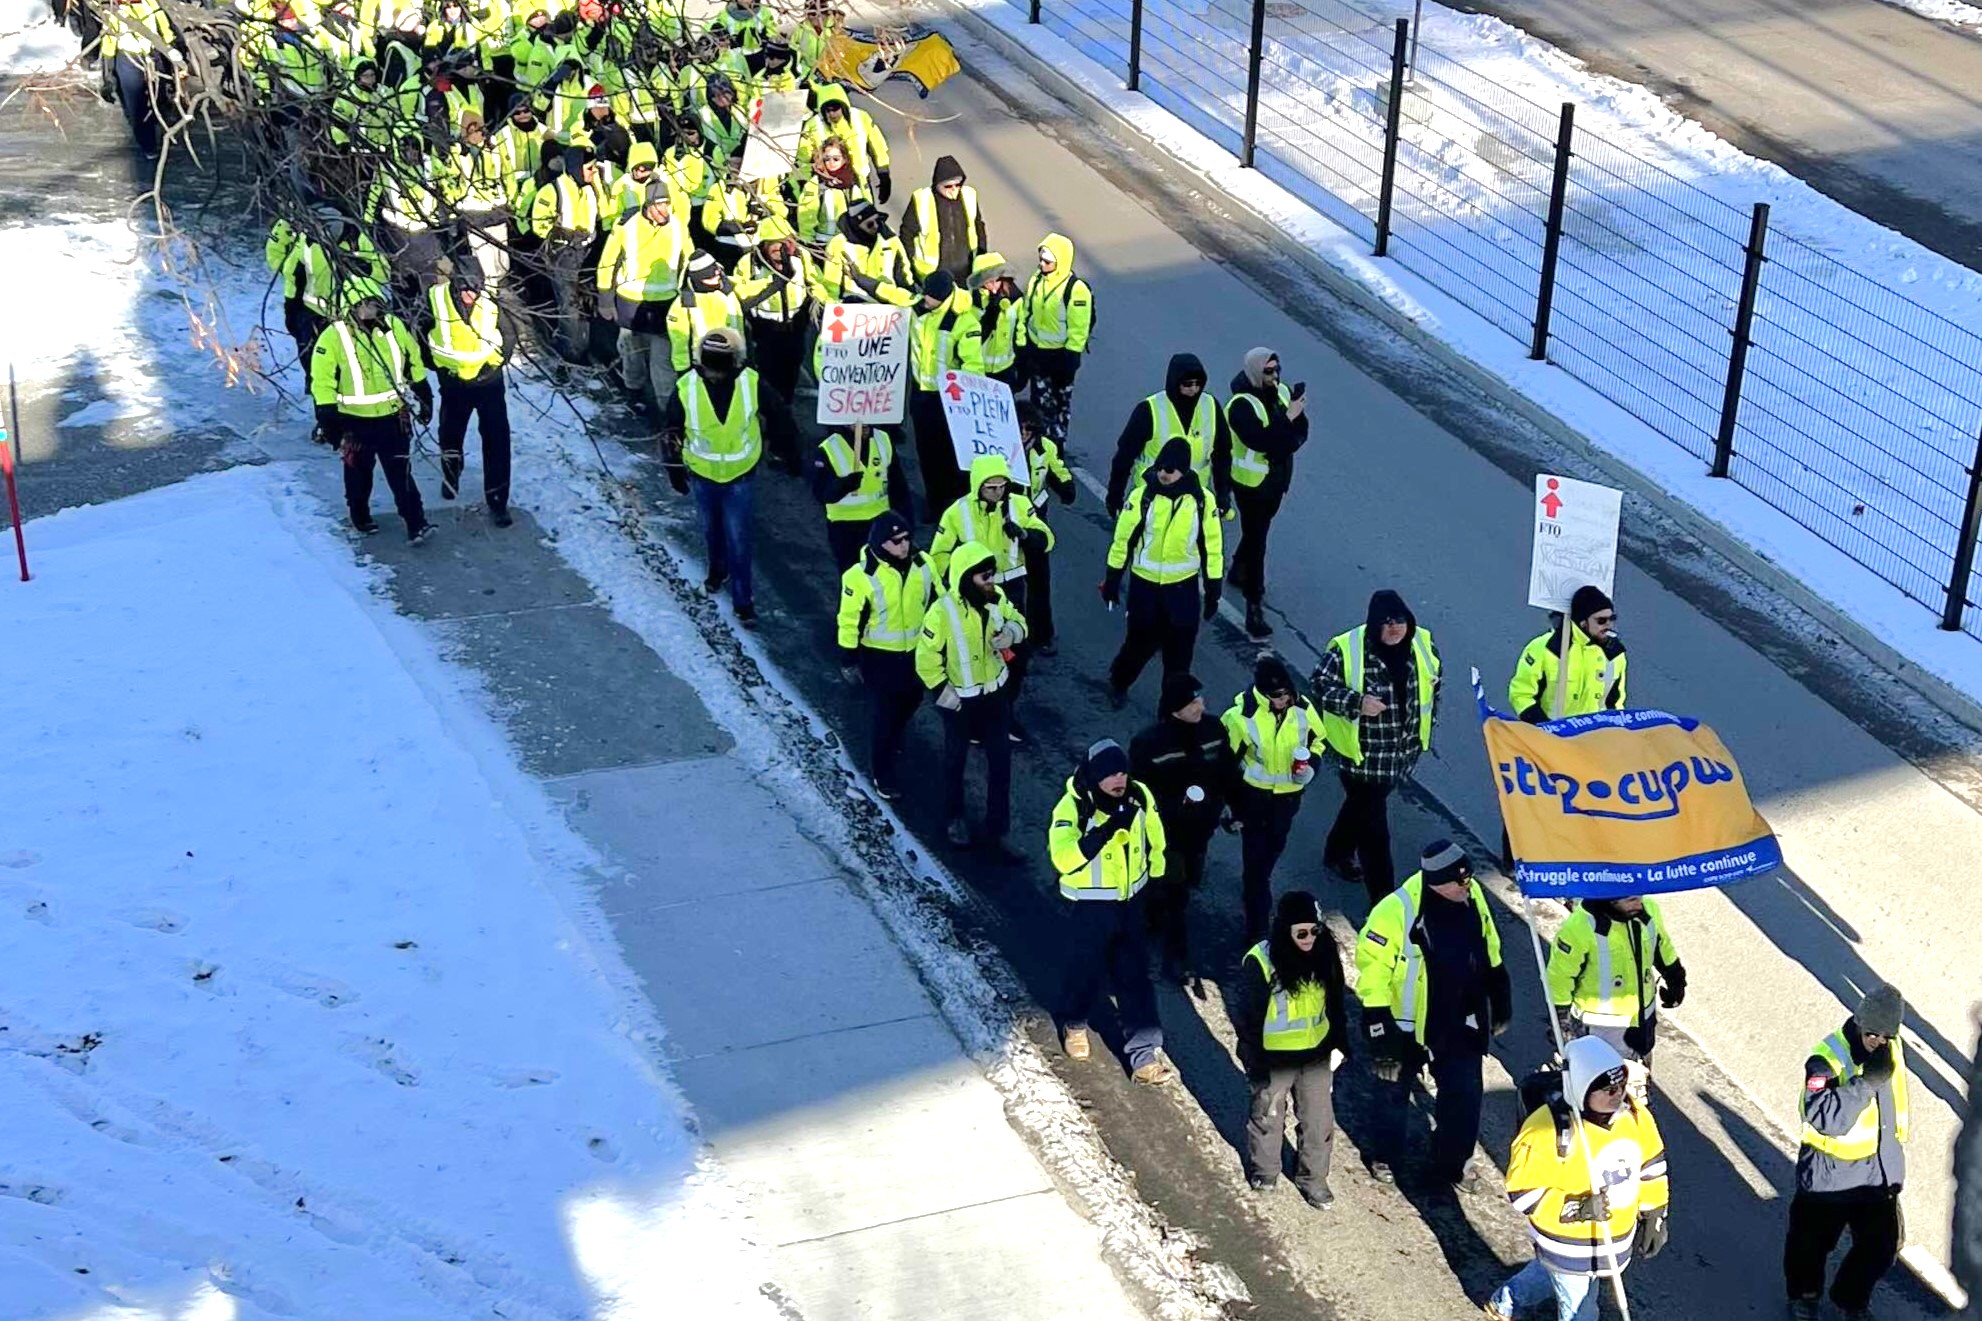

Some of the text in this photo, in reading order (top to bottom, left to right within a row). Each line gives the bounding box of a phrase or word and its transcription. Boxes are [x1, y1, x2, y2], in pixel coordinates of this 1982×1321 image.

[851, 312, 903, 338] POUR
[858, 336, 892, 358] UNE
[821, 361, 901, 385] CONVENTION
[970, 391, 1011, 423] PLEIN
[974, 419, 997, 439] LE
[1567, 715, 1593, 729] The
[1582, 869, 1634, 884] continues
[1647, 867, 1663, 883] La
[1666, 863, 1697, 881] lutte
[1700, 850, 1757, 873] continue
